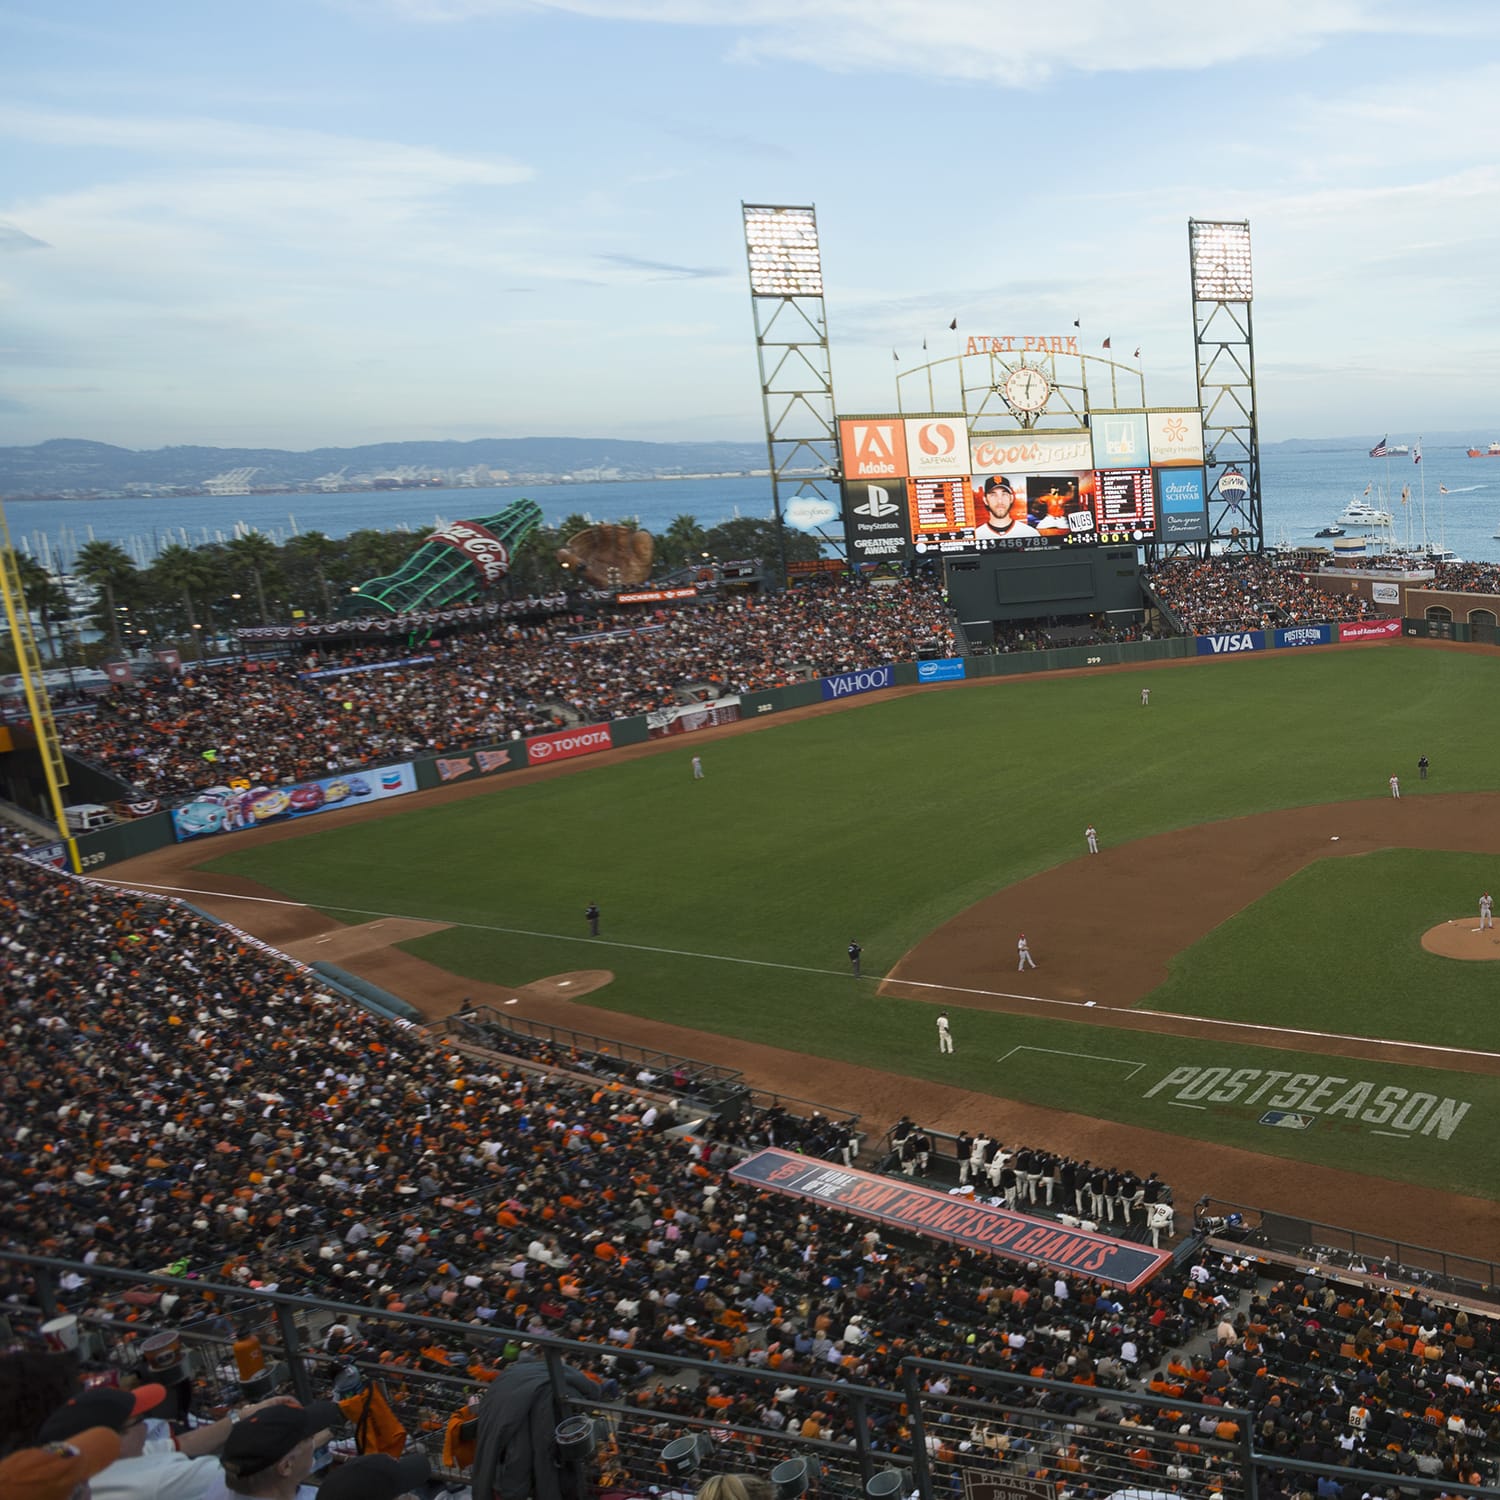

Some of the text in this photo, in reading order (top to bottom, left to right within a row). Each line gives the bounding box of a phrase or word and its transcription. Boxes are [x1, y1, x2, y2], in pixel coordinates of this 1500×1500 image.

[965, 336, 1079, 356] AT&T PARK
[973, 441, 1089, 468] Coors LIGHT
[1153, 445, 1200, 454] Dignity Health
[919, 456, 956, 465] SAFEWAY
[858, 461, 896, 475] Adobe
[1166, 482, 1199, 493] charles
[1166, 493, 1200, 501] SCHWAB
[858, 522, 900, 532] PlayStation
[1070, 513, 1092, 529] NLCS
[854, 538, 905, 548] GREATNESS
[1000, 540, 1006, 548] 4
[1015, 539, 1023, 547] 6
[1025, 538, 1031, 546] 7
[1033, 537, 1040, 545] 8
[1041, 537, 1048, 545] 9
[1101, 534, 1108, 543] 0
[1112, 533, 1119, 542] 0
[1123, 533, 1129, 541] 1
[423, 521, 509, 580] ca-Cola
[864, 545, 899, 555] AWAITS
[1284, 628, 1321, 642] POSTSEASON
[1343, 629, 1357, 637] Bank
[1363, 626, 1386, 635] America
[1208, 634, 1253, 652] VISA
[921, 664, 937, 672] intel
[827, 668, 888, 697] YAHOO!
[553, 732, 611, 751] TOYOTA
[80, 852, 106, 866] 339
[1142, 1066, 1472, 1140] POSTSEASON
[817, 1169, 858, 1187] HOME
[801, 1180, 841, 1197] OF THE
[838, 1181, 1119, 1271] SAN FRANCISCO GIANTS
[982, 1473, 1037, 1493] PLEASE
[993, 1489, 1007, 1500] DO
